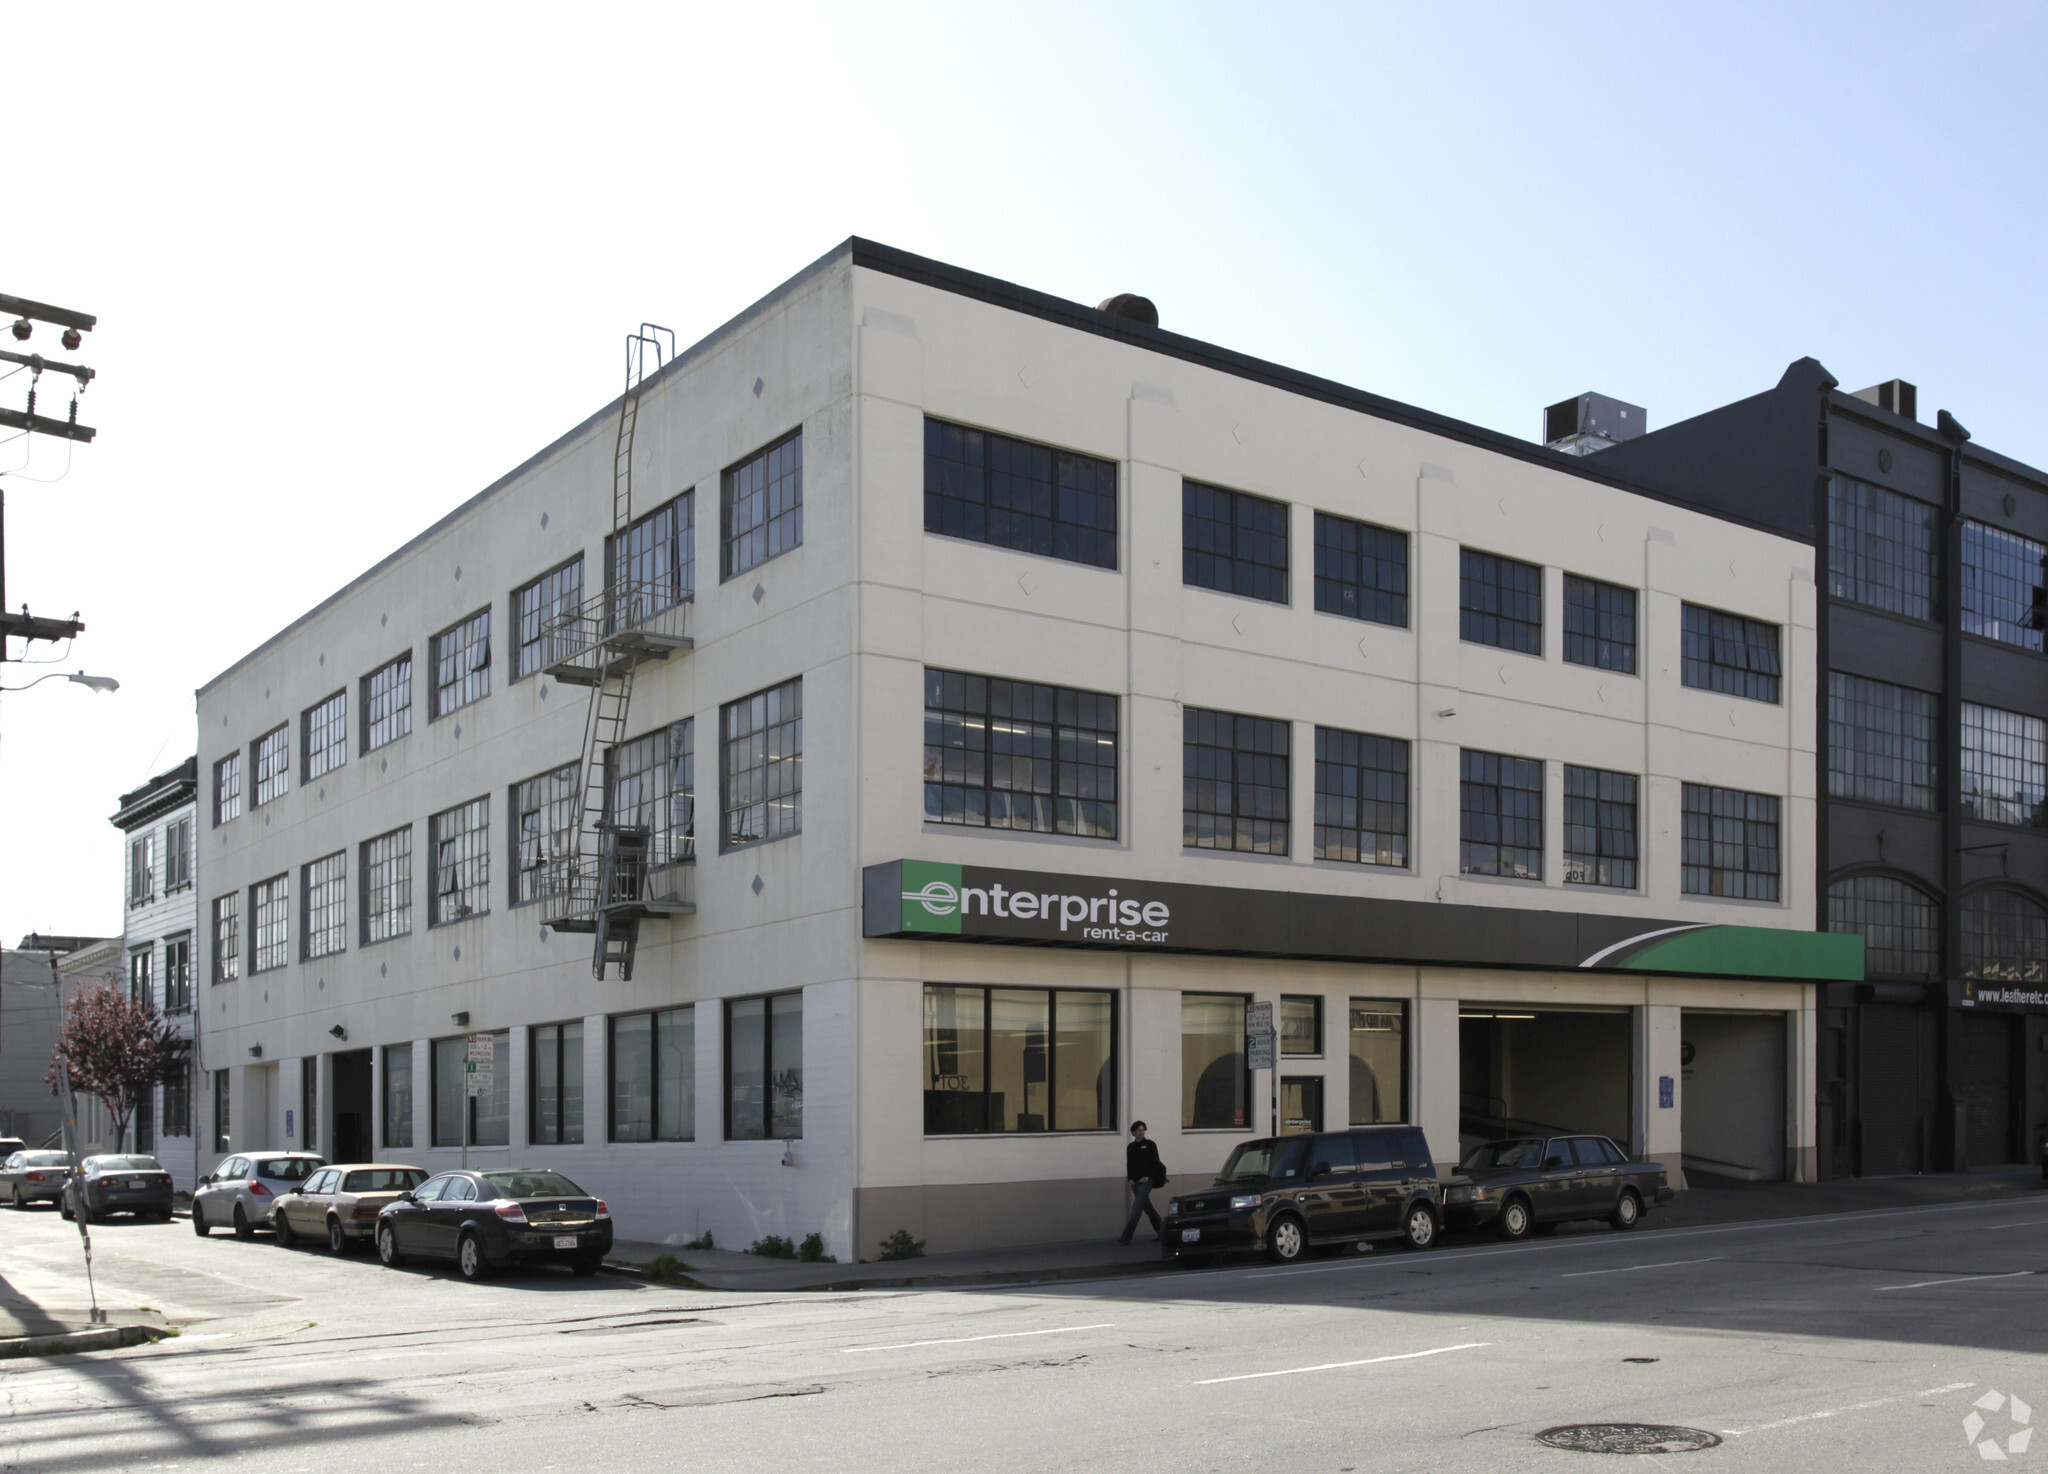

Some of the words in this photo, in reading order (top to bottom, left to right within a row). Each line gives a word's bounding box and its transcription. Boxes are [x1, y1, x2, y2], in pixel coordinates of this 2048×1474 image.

[919, 880, 1170, 932] enterprise
[1083, 926, 1169, 943] rent-a-car
[1249, 1038, 1256, 1047] 2
